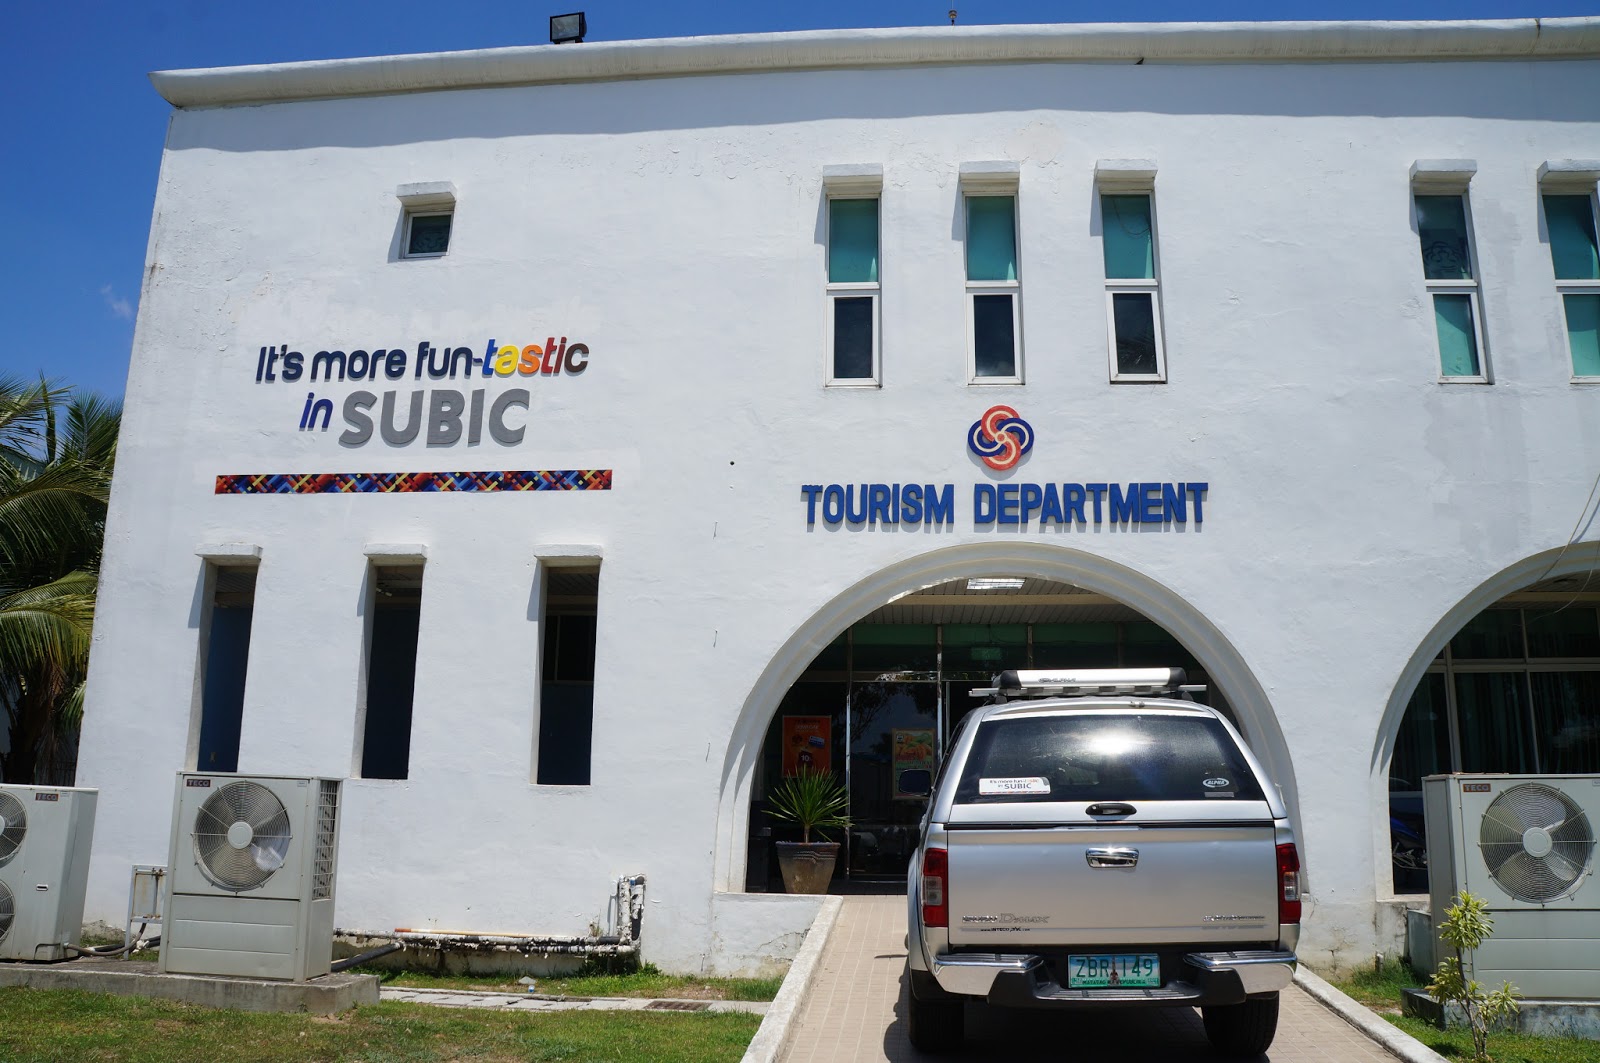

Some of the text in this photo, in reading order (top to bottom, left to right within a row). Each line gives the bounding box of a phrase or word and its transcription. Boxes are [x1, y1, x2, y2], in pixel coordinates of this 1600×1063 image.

[256, 337, 589, 383] It's more fun-tastic
[300, 388, 530, 447] in SUBIC
[801, 482, 1208, 524] TOURISM DEPARTMENT
[36, 793, 57, 801] TECO
[1076, 958, 1153, 977] ZBR 149
